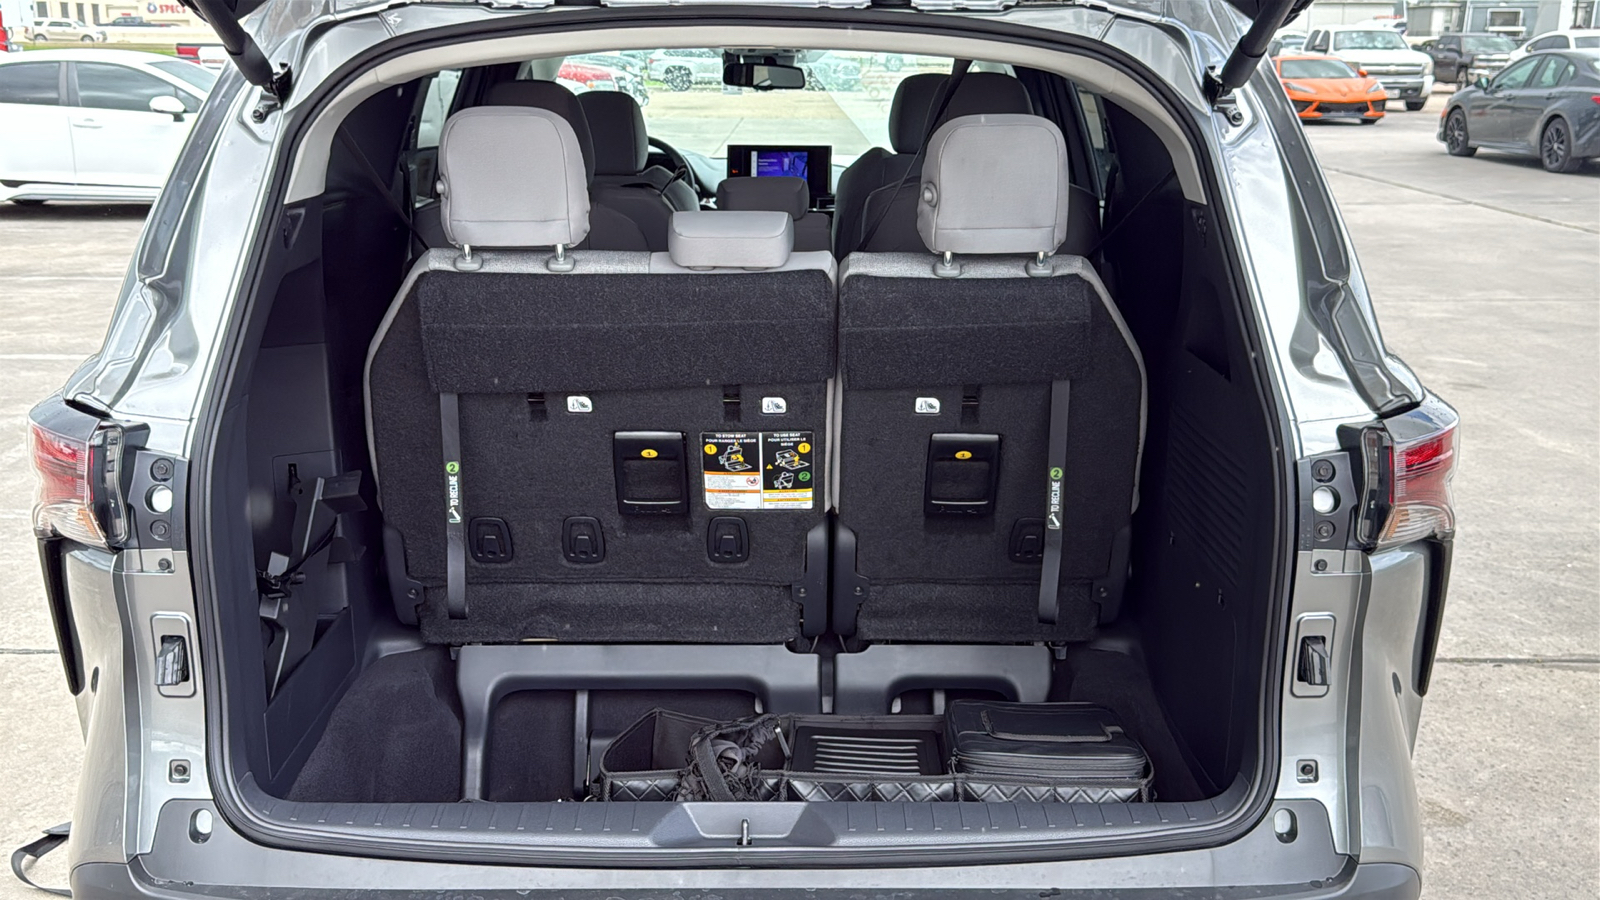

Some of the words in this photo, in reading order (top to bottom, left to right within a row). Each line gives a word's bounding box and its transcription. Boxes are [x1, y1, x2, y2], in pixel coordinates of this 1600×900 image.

[449, 475, 458, 498] RECLINE
[1051, 481, 1060, 504] RECLINE
[450, 498, 459, 506] TO
